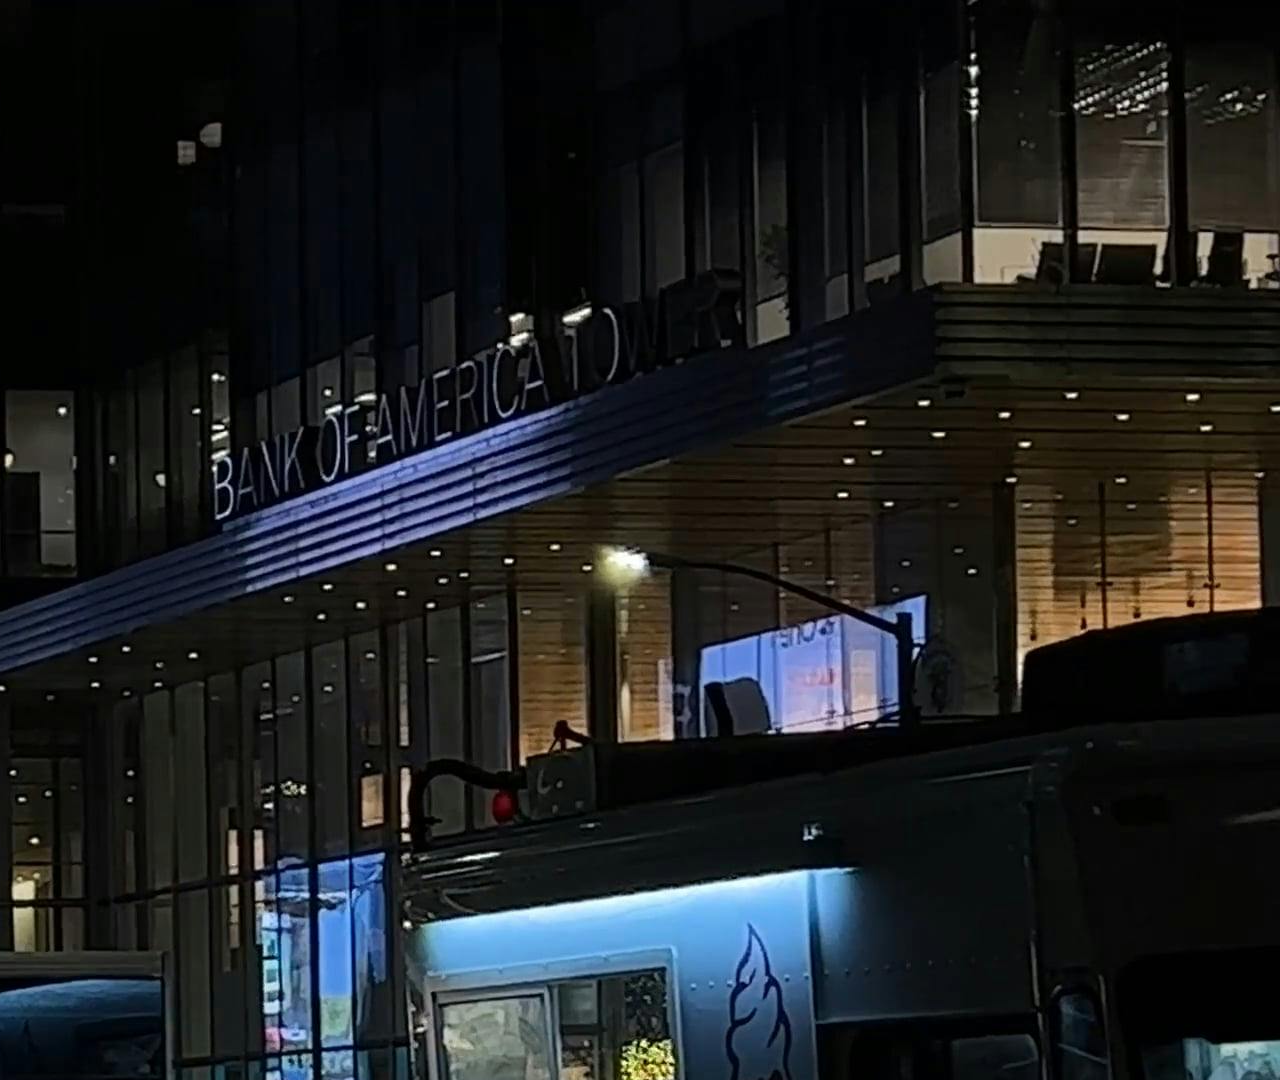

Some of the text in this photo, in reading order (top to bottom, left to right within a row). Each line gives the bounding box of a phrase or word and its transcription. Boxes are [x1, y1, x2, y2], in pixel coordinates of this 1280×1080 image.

[212, 425, 305, 521] BANK
[320, 403, 360, 483] OF
[374, 339, 550, 458] AMERICA
